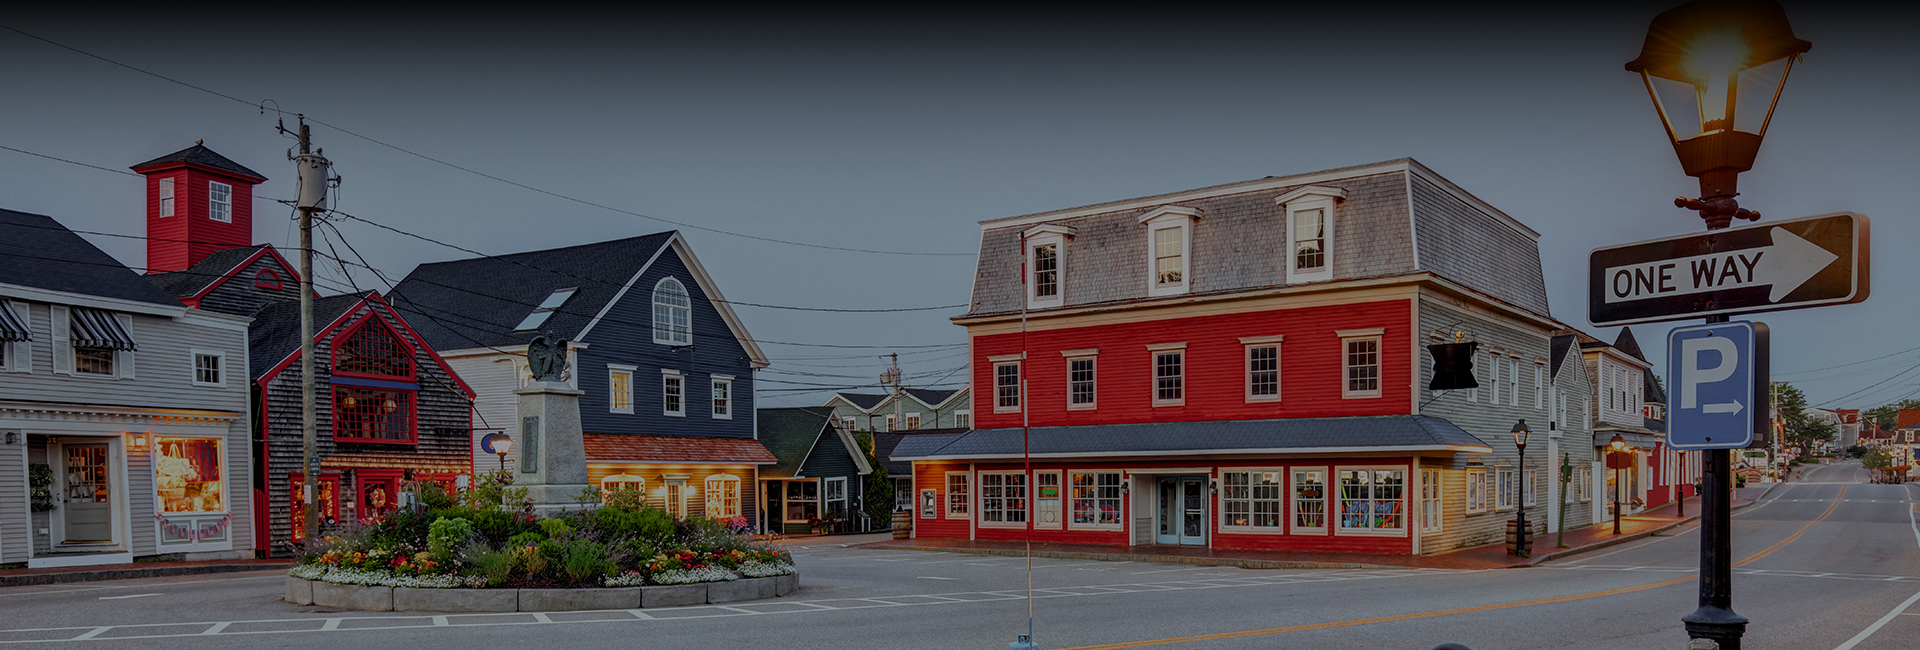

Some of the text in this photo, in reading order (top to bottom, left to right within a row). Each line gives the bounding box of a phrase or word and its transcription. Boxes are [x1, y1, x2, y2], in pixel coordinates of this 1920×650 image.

[1613, 251, 1764, 298] ONE WAY
[1681, 336, 1738, 409] P
